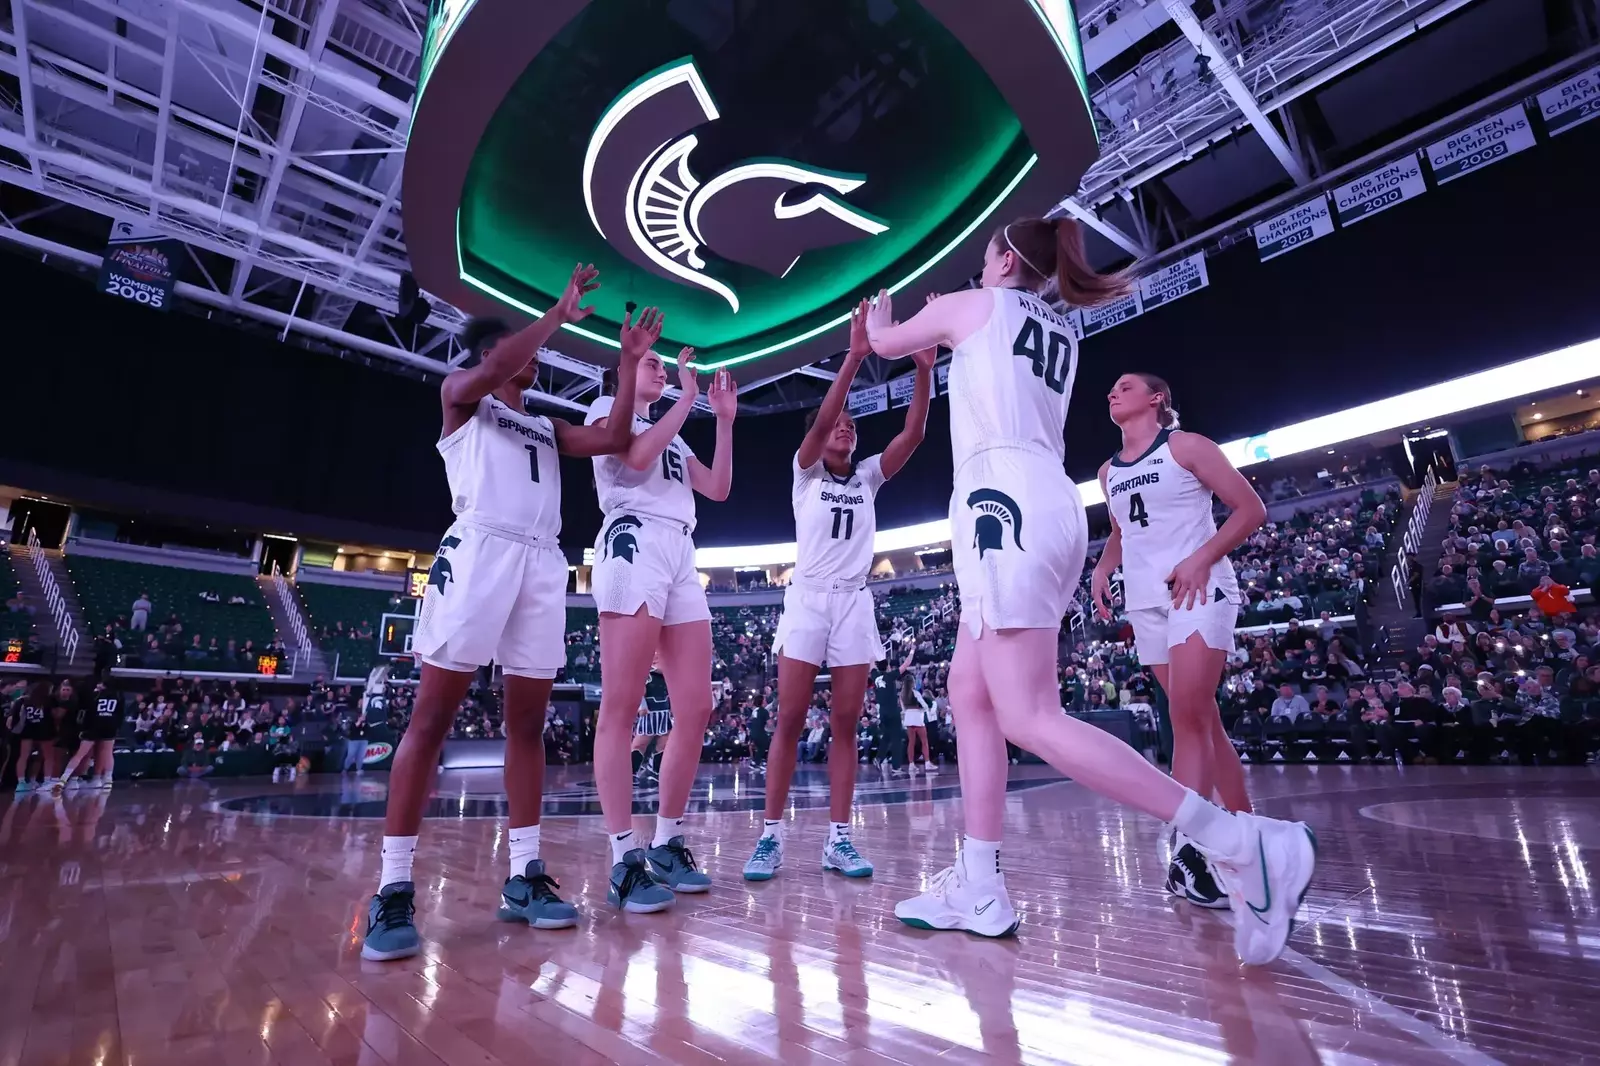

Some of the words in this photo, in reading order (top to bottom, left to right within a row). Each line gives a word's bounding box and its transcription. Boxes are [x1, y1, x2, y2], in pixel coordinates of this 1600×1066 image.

[1546, 83, 1600, 114] CHAM
[1561, 78, 1589, 96] BIG
[1580, 100, 1600, 116] 20
[1433, 119, 1526, 165] CHAMPIONS
[1446, 130, 1471, 149] BIG
[1474, 118, 1504, 138] TEN
[1459, 144, 1505, 170] 2009
[1339, 167, 1419, 208] CHAMPIONS
[1351, 177, 1372, 193] BIG
[1375, 166, 1400, 184] TEN
[1364, 190, 1399, 212] 2010
[1258, 208, 1328, 245] CHAMPIONS
[1269, 216, 1287, 231] BIG
[1288, 206, 1312, 224] TEN
[1281, 229, 1311, 249] 2012
[109, 272, 165, 296] WOMEN'S
[1149, 264, 1197, 290] TOURNAMENT
[1150, 269, 1200, 296] CHAMPIONS
[105, 281, 164, 308] 2005
[1161, 283, 1189, 301] 2012
[1090, 298, 1136, 322] CHAMPIONS
[1101, 310, 1126, 329] 2014
[1012, 316, 1072, 395] 40
[850, 393, 886, 407] CHAMPIONS
[498, 417, 554, 449] SPARTANS
[524, 444, 540, 484] 1
[662, 448, 684, 485] 15
[1111, 472, 1160, 497] SPARTANS
[820, 491, 864, 505] SPARTANS
[1128, 492, 1149, 528] 4
[831, 507, 854, 540] 11
[26, 707, 44, 720] 24
[97, 699, 117, 712] 20
